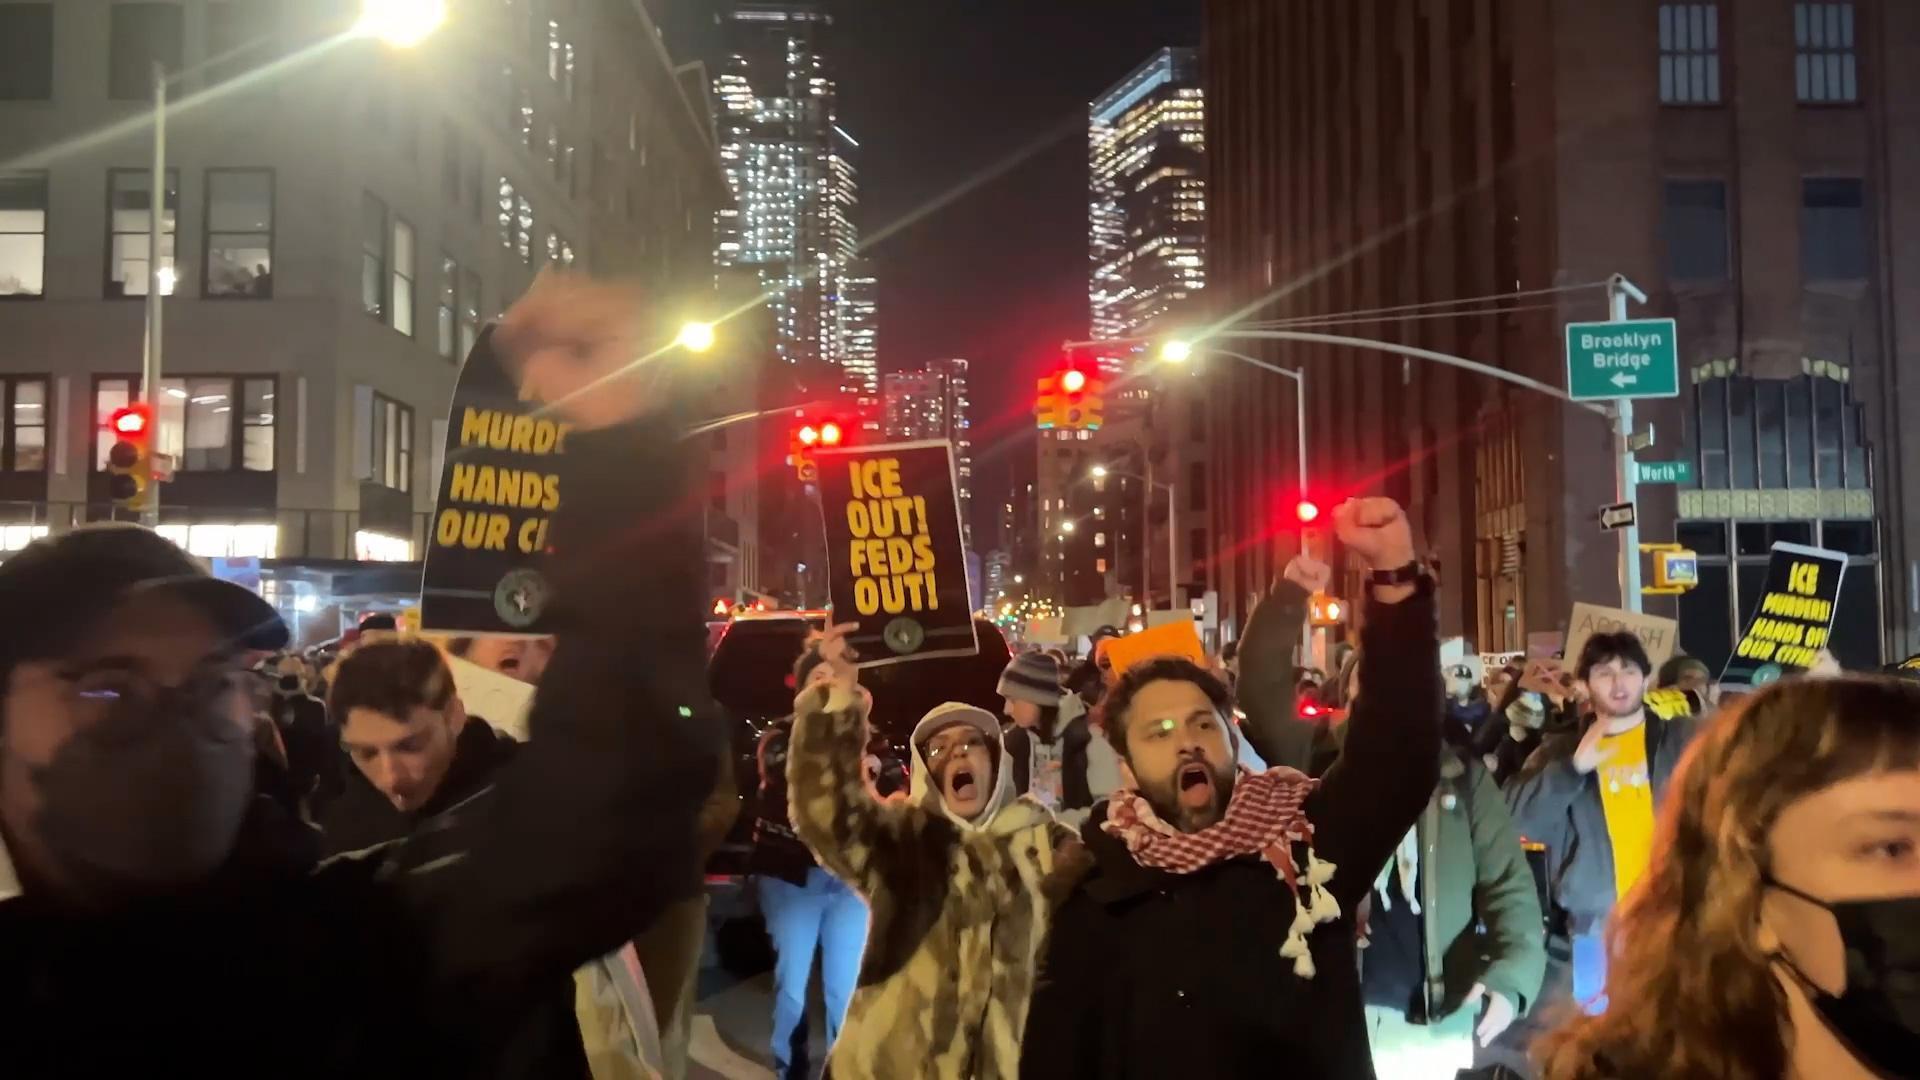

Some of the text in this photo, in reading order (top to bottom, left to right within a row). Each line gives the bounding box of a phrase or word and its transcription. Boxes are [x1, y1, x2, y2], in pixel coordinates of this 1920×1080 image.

[1581, 332, 1662, 350] Brooklyn
[1593, 352, 1652, 370] Bridge
[450, 463, 560, 512] HANDS
[849, 458, 902, 499] ICE
[1641, 464, 1675, 481] Worth
[437, 508, 510, 551] OUR
[847, 495, 928, 538] OUT!
[850, 534, 936, 577] FEDS
[854, 570, 939, 616] OUT!
[1788, 561, 1820, 596] ICE
[1749, 617, 1805, 646] HANDS
